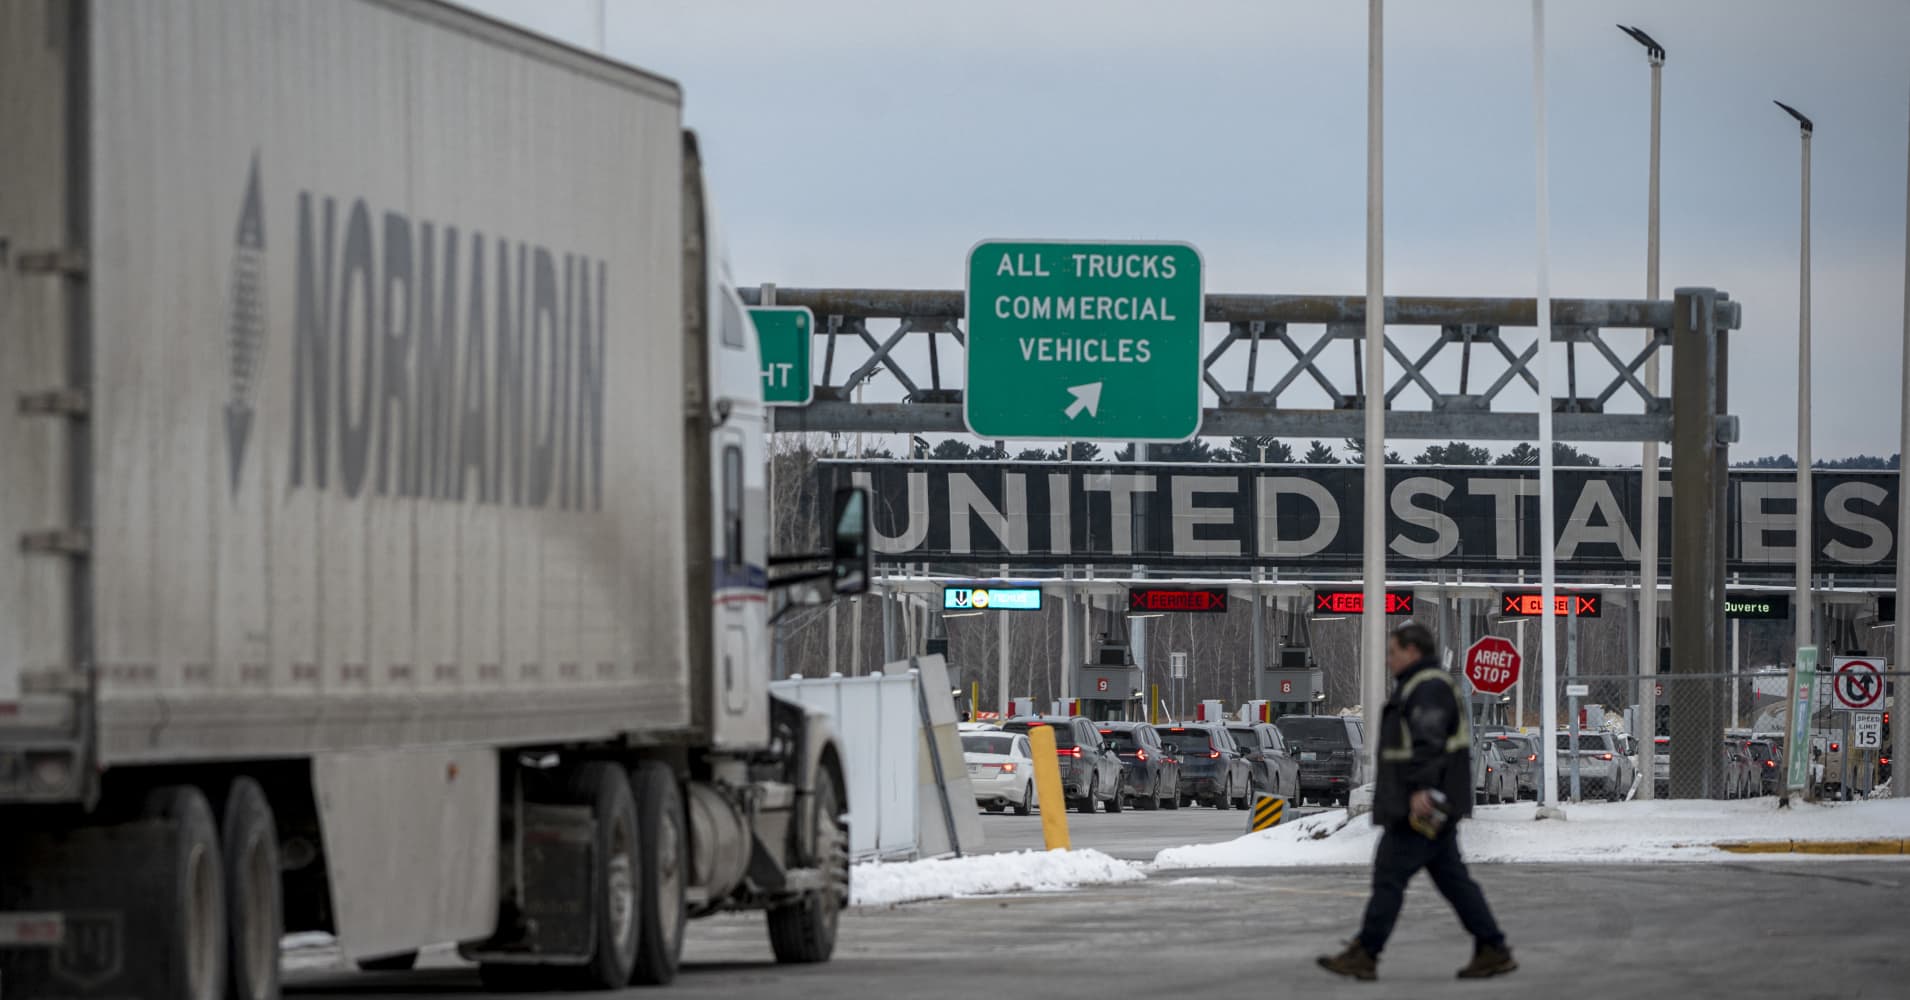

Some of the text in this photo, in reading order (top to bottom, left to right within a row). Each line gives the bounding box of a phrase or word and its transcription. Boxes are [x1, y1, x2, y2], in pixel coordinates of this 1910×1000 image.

[997, 253, 1177, 279] ALL TRUCKS
[995, 295, 1176, 321] COMMERCIAL
[290, 190, 606, 512] NORMANDIN
[1019, 337, 1151, 363] VEHICLES
[850, 472, 1894, 565] UNITED STAES
[1474, 649, 1514, 668] ARRÊT
[1100, 680, 1108, 691] 9
[1473, 665, 1511, 684] STOP
[1283, 682, 1291, 693] 8
[1859, 731, 1877, 745] 15
